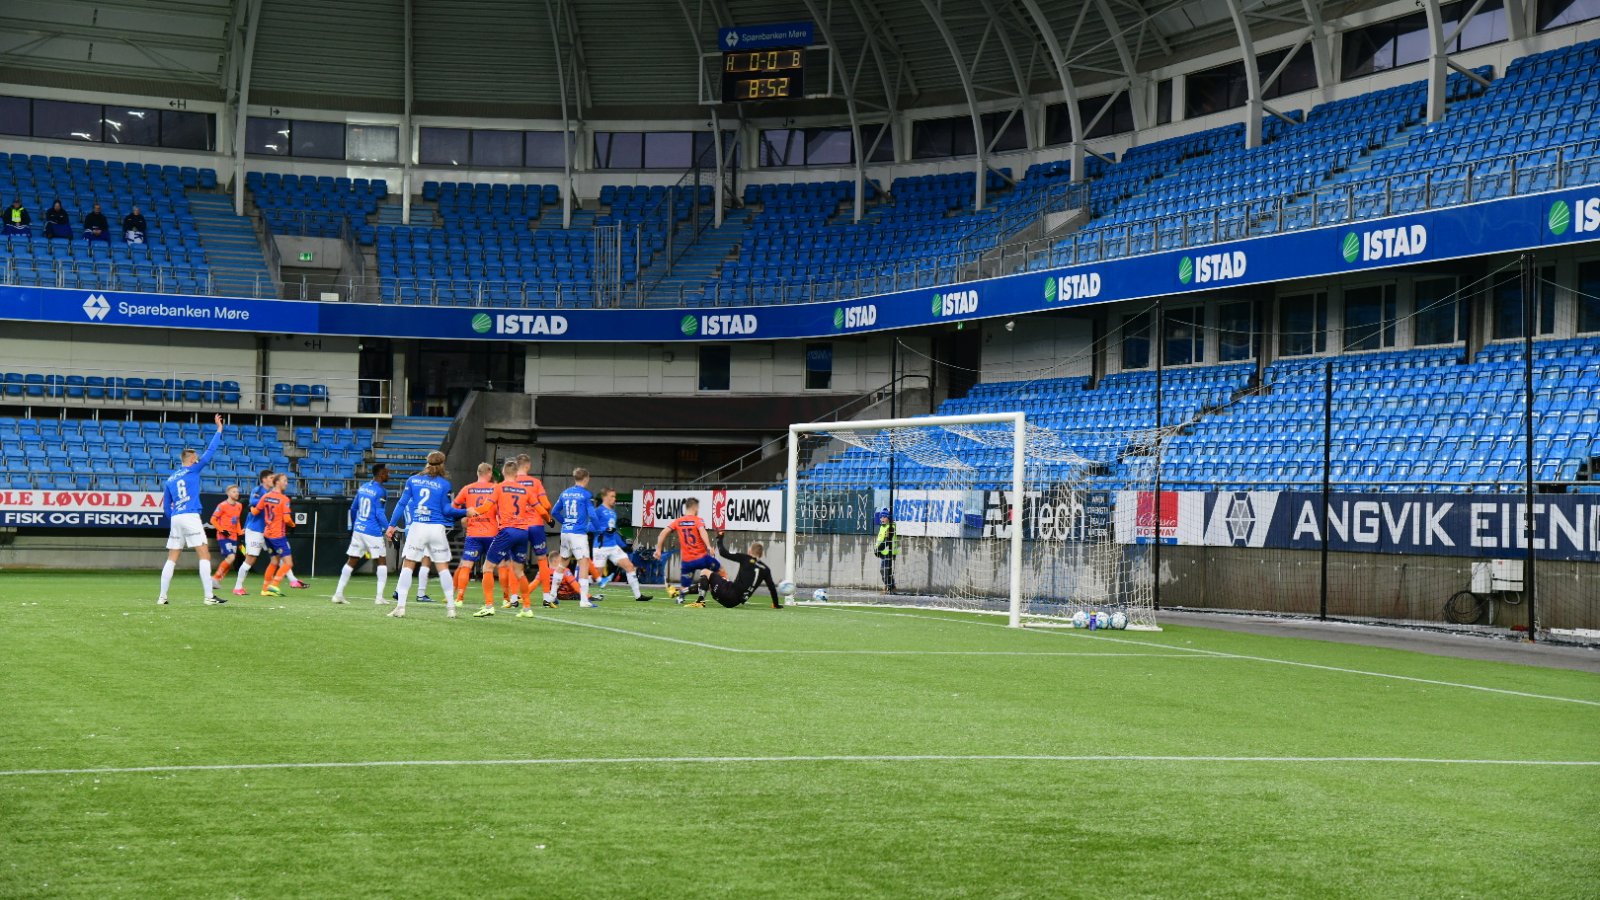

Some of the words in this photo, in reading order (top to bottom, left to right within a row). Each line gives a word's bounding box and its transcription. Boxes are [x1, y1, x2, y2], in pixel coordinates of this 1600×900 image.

[742, 32, 787, 42] Sparebanken
[788, 30, 807, 38] Møre
[726, 56, 735, 70] H
[792, 52, 800, 66] B
[749, 78, 789, 98] 8:52
[1363, 223, 1428, 261] ISTAD
[1195, 250, 1247, 283] ISTAD
[1058, 272, 1101, 301] ISTAD
[118, 302, 211, 318] Sparebanken
[214, 306, 250, 320] Møre
[941, 289, 979, 317] ISTAD
[496, 314, 568, 335] ISTAD
[701, 315, 758, 336] ISTAD
[845, 304, 877, 329] ISTAD
[0, 491, 33, 506] LE
[42, 491, 132, 508] LØVOLD
[177, 479, 188, 499] 6
[359, 496, 371, 519] 10
[418, 488, 431, 512] 2
[511, 495, 520, 516] 3
[564, 499, 578, 518] 14
[655, 498, 687, 520] GLAMO
[727, 498, 771, 523] GLAMOX
[4, 512, 46, 524] FISK
[49, 512, 80, 525] OG
[84, 513, 164, 526] FISKMAT
[893, 499, 944, 523] ROSTEIN
[945, 500, 964, 524] AS
[1293, 500, 1456, 547] ANGVIK
[682, 528, 697, 546] 15
[751, 567, 760, 587] 1
